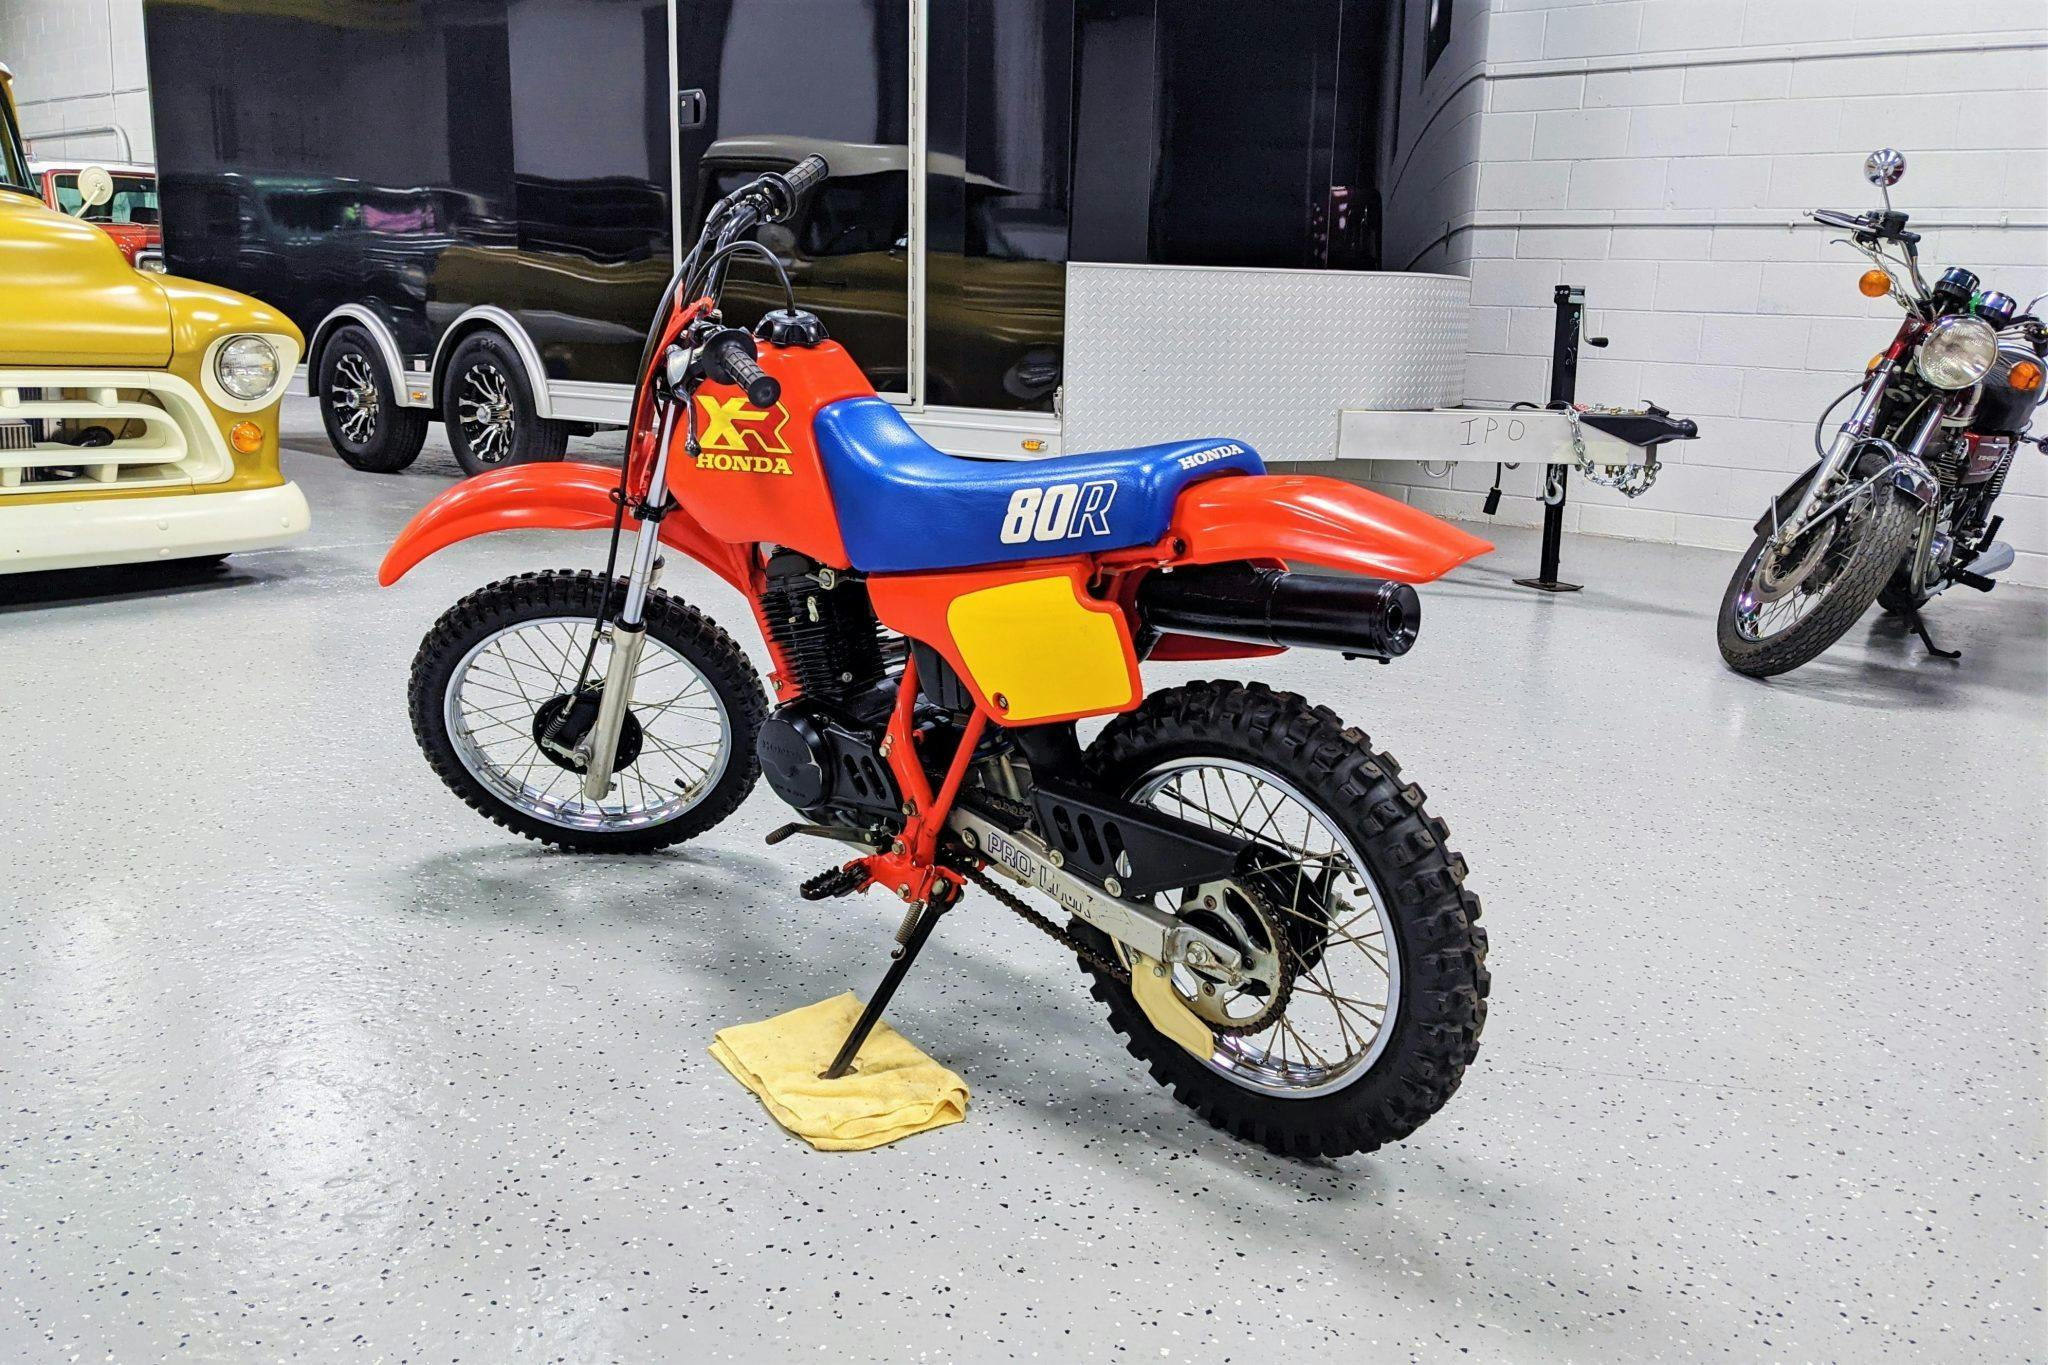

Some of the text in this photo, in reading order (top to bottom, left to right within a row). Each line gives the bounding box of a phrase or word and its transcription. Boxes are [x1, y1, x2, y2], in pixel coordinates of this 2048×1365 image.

[697, 396, 793, 454] XR
[696, 453, 793, 475] HONDA
[1177, 443, 1245, 471] HONDA
[1000, 480, 1118, 544] 80R
